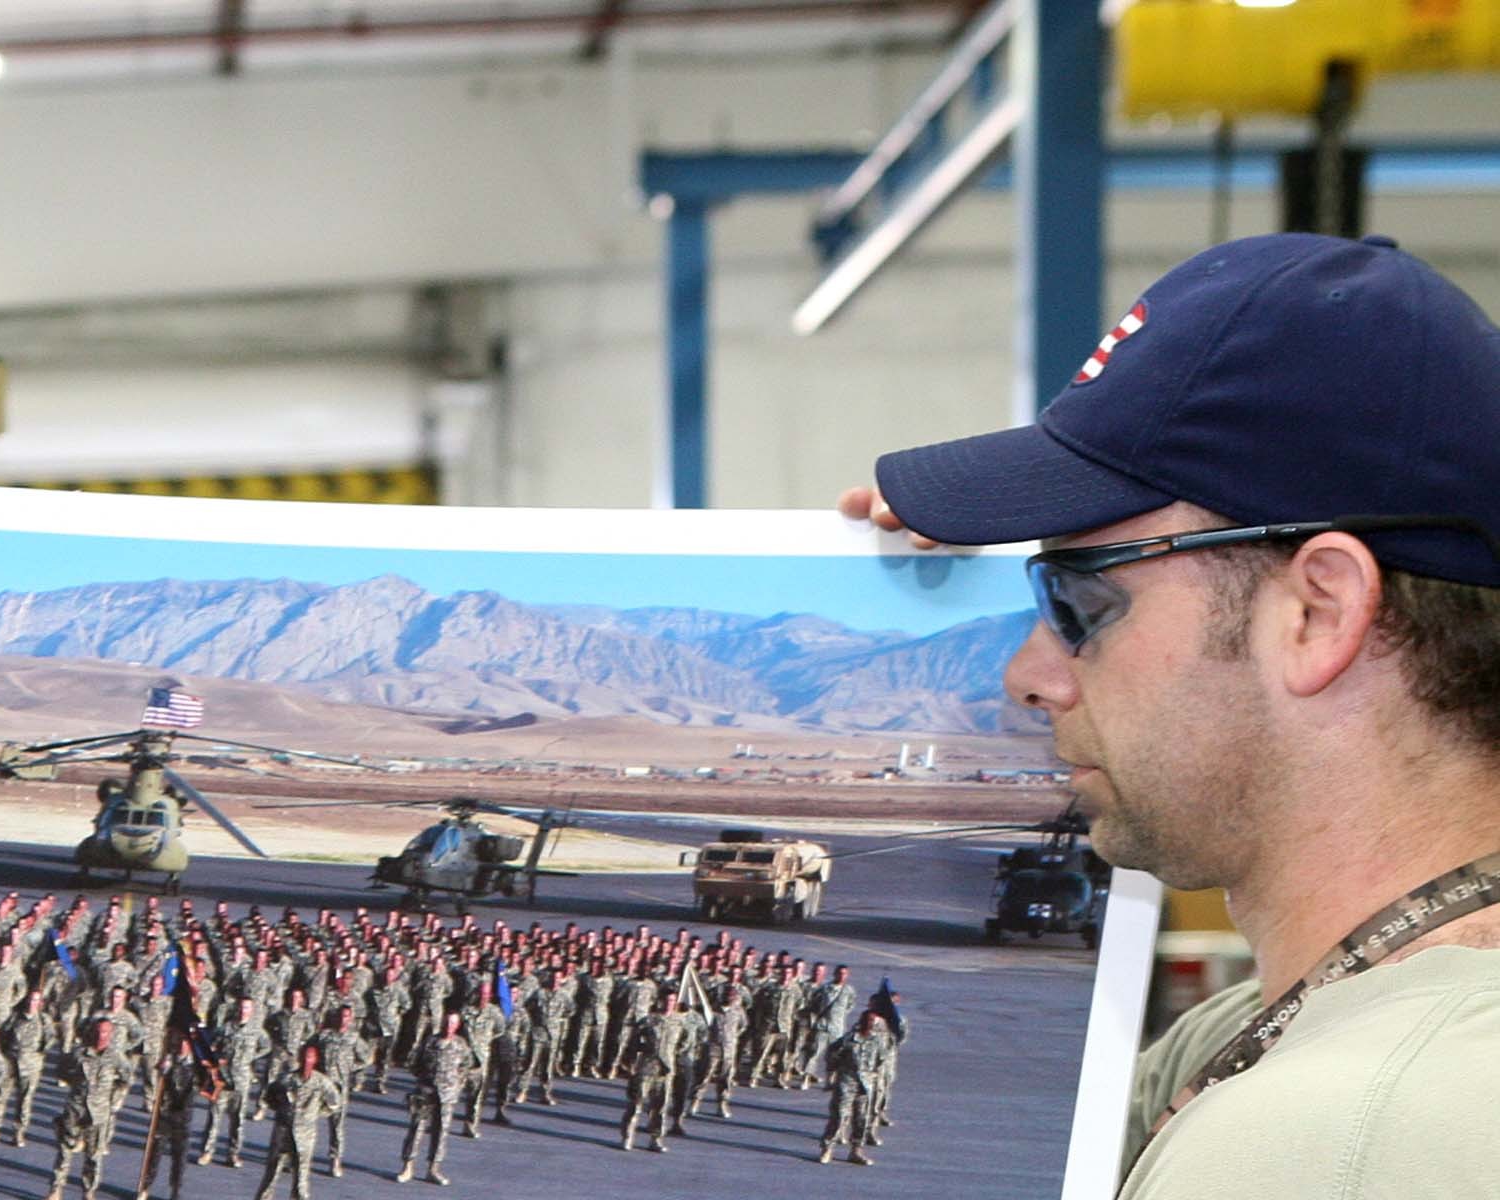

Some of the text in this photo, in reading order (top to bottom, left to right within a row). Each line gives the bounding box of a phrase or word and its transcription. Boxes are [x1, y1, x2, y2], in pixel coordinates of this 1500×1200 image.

[1442, 871, 1493, 904] THEN
[1367, 896, 1444, 949] THERE'S
[1319, 944, 1365, 984] ARMY
